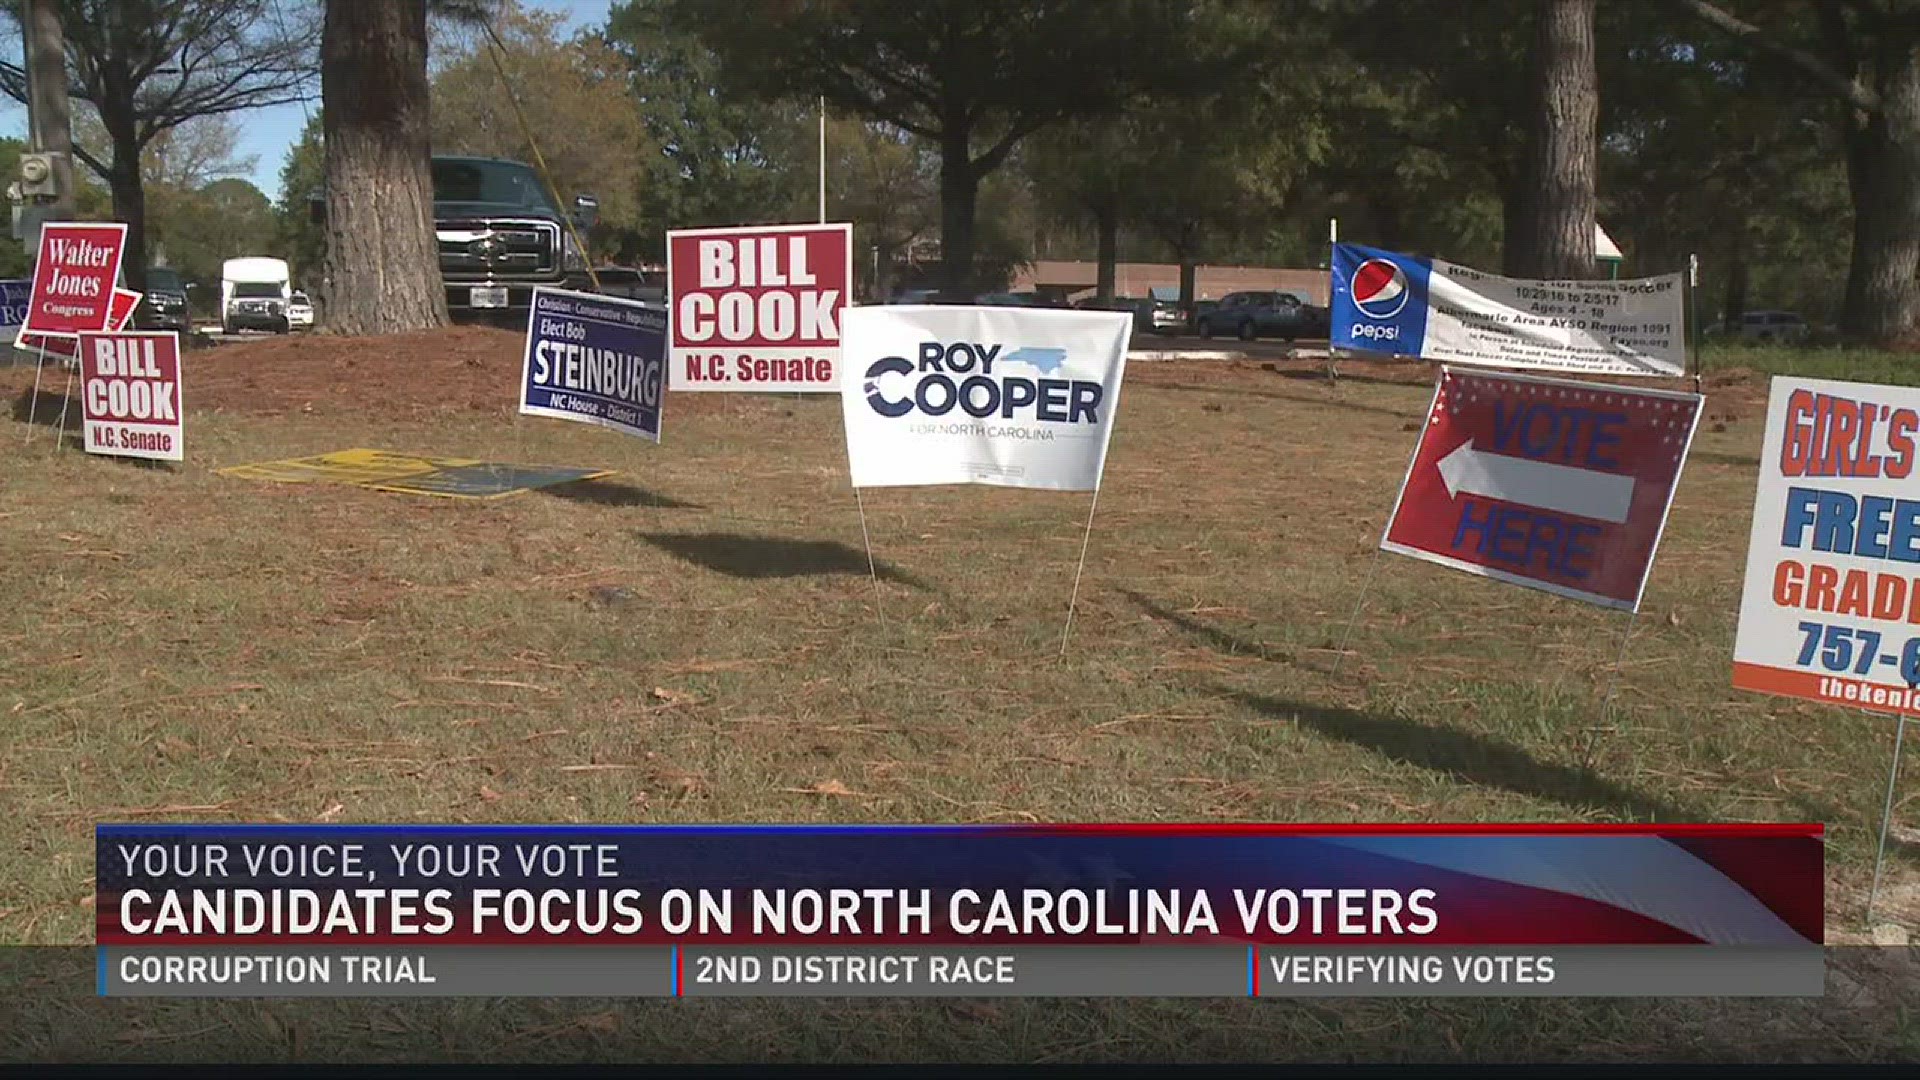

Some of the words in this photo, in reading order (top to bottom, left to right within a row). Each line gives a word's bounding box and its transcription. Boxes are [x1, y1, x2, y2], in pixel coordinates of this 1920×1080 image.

[49, 238, 114, 267] Walter
[699, 236, 816, 288] BILL
[46, 268, 101, 297] Jones
[1568, 288, 1580, 302] to
[42, 302, 95, 318] Congress
[679, 290, 840, 341] COOK
[1513, 314, 1545, 326] Area
[1550, 316, 1586, 330] AYSO
[1591, 321, 1637, 334] Region
[1643, 323, 1671, 334] 1091
[1531, 302, 1566, 315] Ages
[1568, 305, 1577, 315] 4
[1591, 307, 1605, 318] 18
[540, 318, 565, 336] Elect
[566, 321, 586, 340] Bob
[1351, 322, 1399, 341] pepsi
[94, 338, 161, 377] BILL
[685, 354, 731, 381] N.C.
[737, 355, 832, 382] Senate
[918, 342, 1002, 374] ROY
[533, 339, 659, 407] STEINBURG
[87, 378, 175, 420] COOK
[550, 393, 566, 408] NC
[567, 395, 599, 415] House
[863, 355, 1103, 424] COOPER
[93, 426, 118, 447] N.C.
[121, 427, 171, 451] Senate
[909, 423, 937, 435] FOR
[938, 423, 986, 437] NORTH
[987, 426, 1055, 441] CAROLINA
[1493, 400, 1629, 468] VOTE
[1780, 388, 1919, 479] GIRL'S
[1780, 486, 1920, 563] FREE
[1452, 502, 1601, 578] HERE
